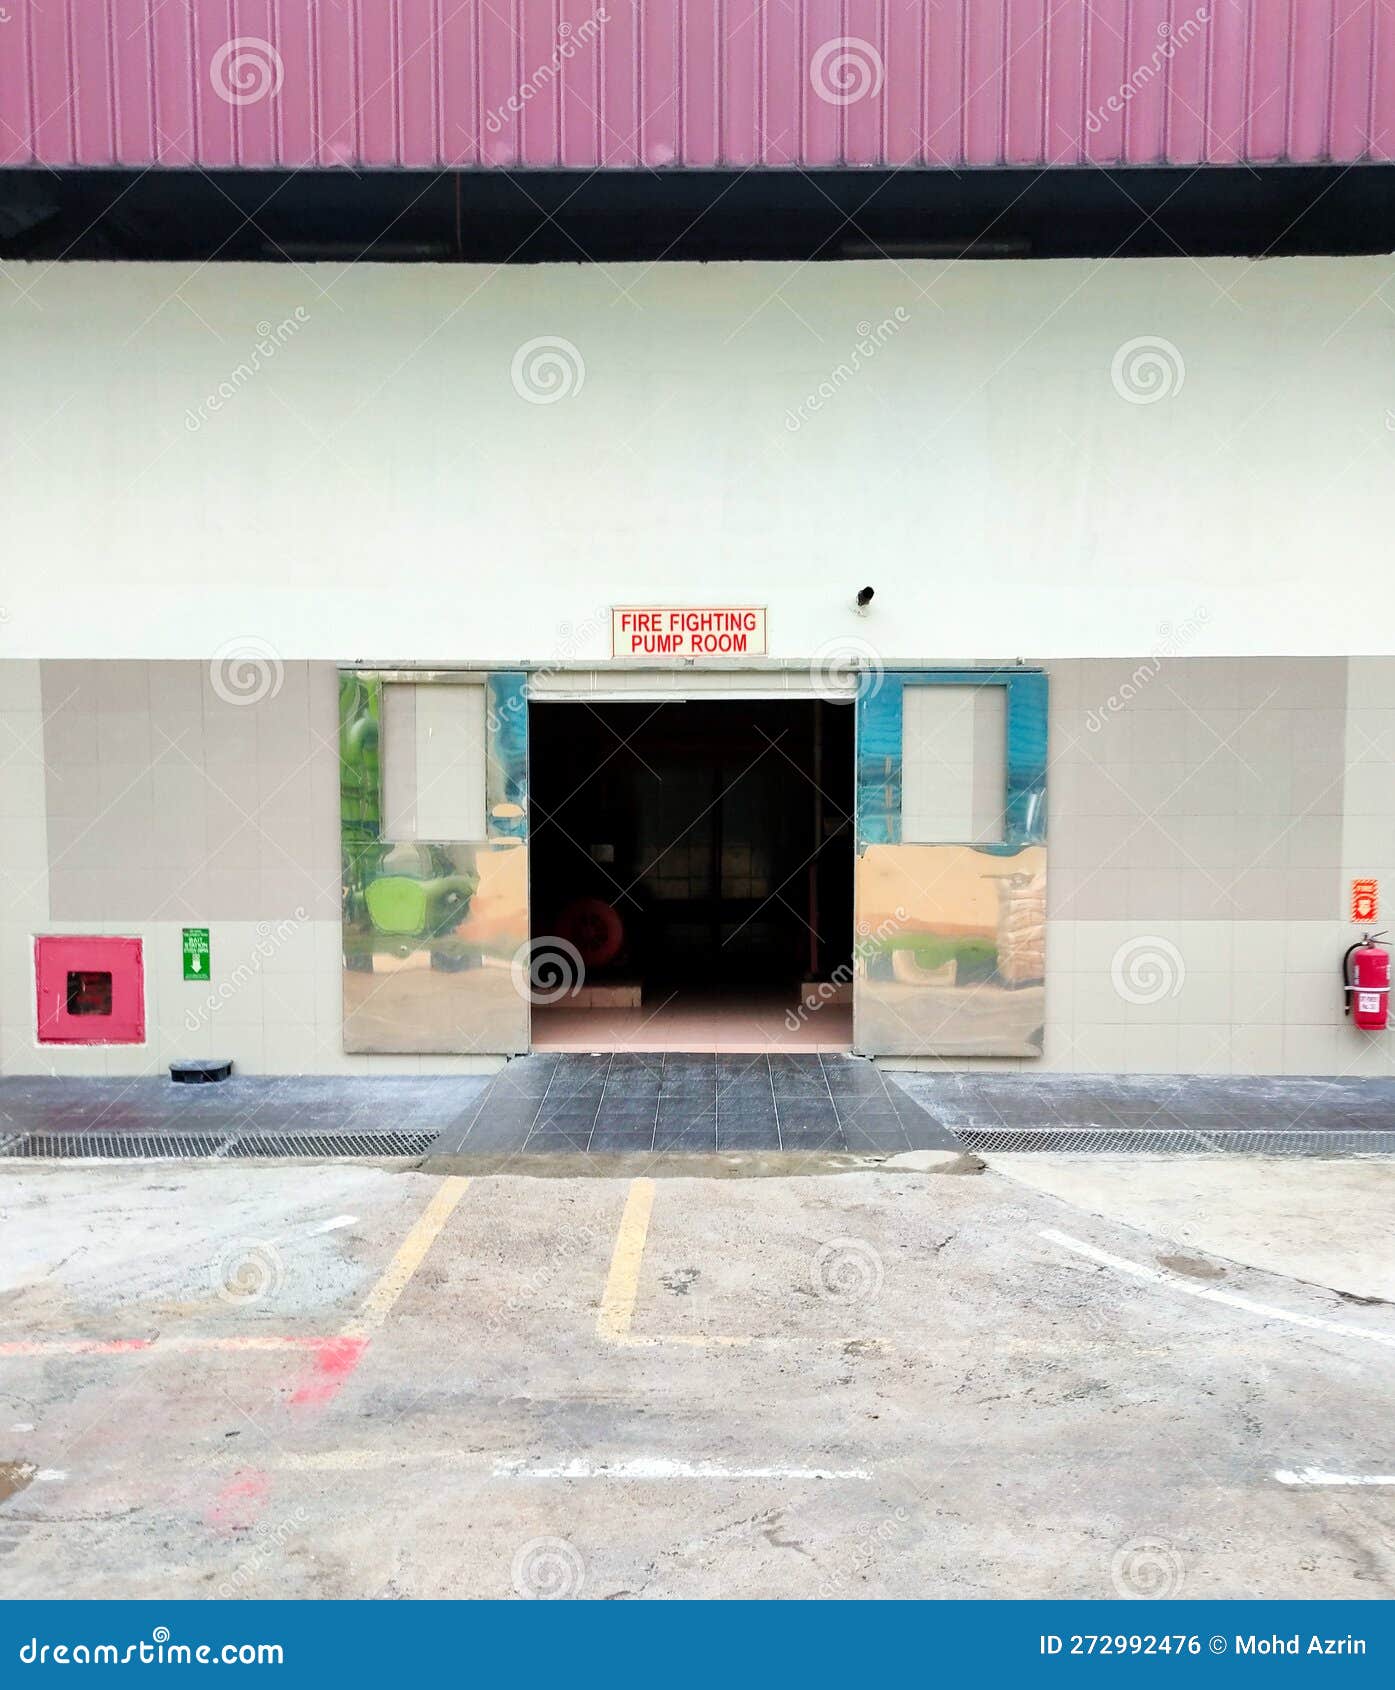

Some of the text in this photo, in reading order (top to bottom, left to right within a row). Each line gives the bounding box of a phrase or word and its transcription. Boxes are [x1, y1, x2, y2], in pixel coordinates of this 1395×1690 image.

[621, 613, 756, 632] FIRE FIGHTING
[631, 634, 747, 653] PUMP ROOM
